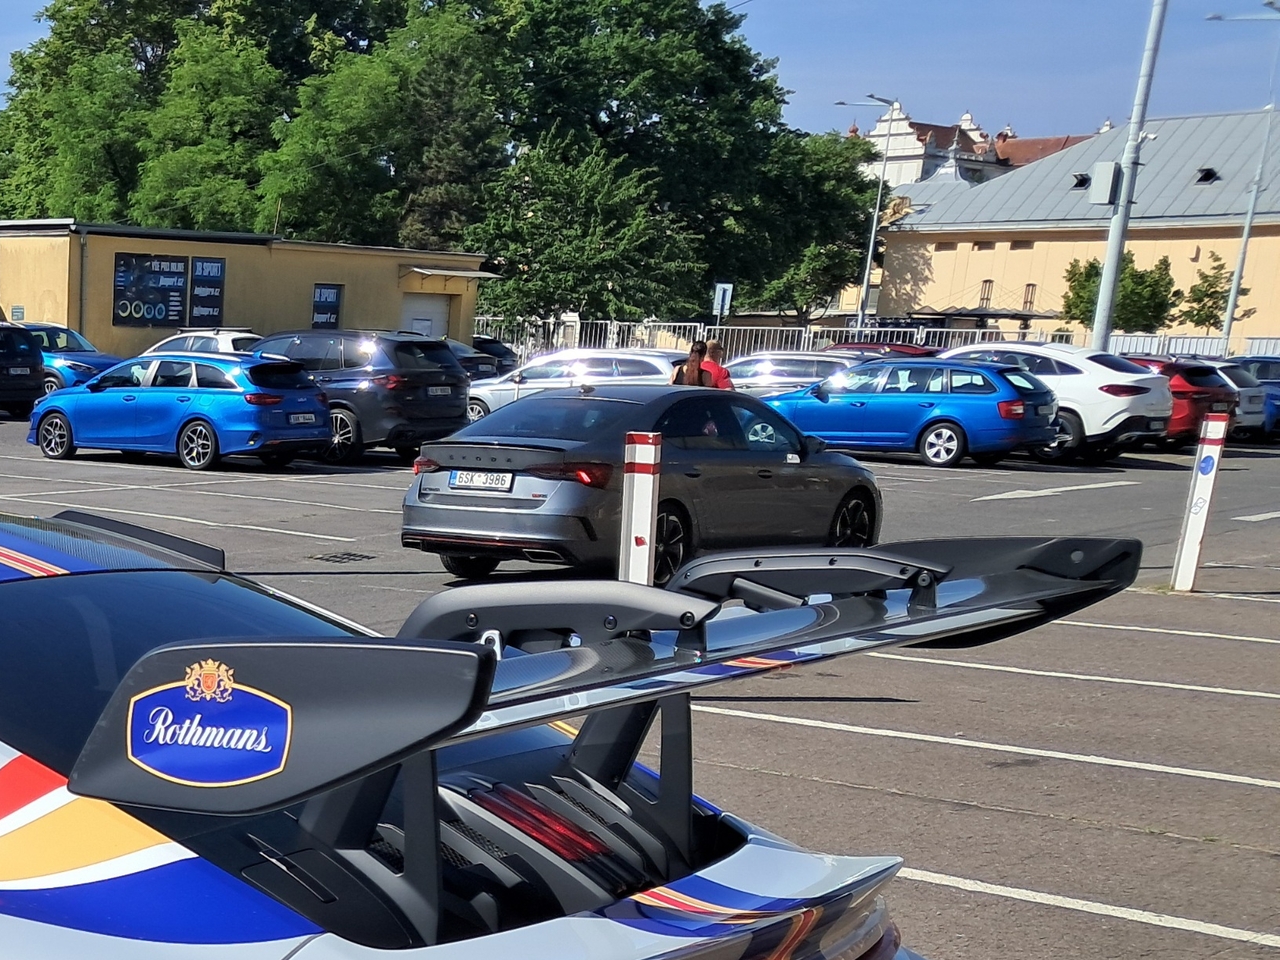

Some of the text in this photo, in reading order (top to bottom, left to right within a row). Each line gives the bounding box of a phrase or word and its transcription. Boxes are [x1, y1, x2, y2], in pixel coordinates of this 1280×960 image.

[203, 262, 221, 277] SPORT
[320, 288, 337, 302] SPORT
[458, 472, 508, 486] 6SK 3986
[143, 706, 273, 753] Rothmans
